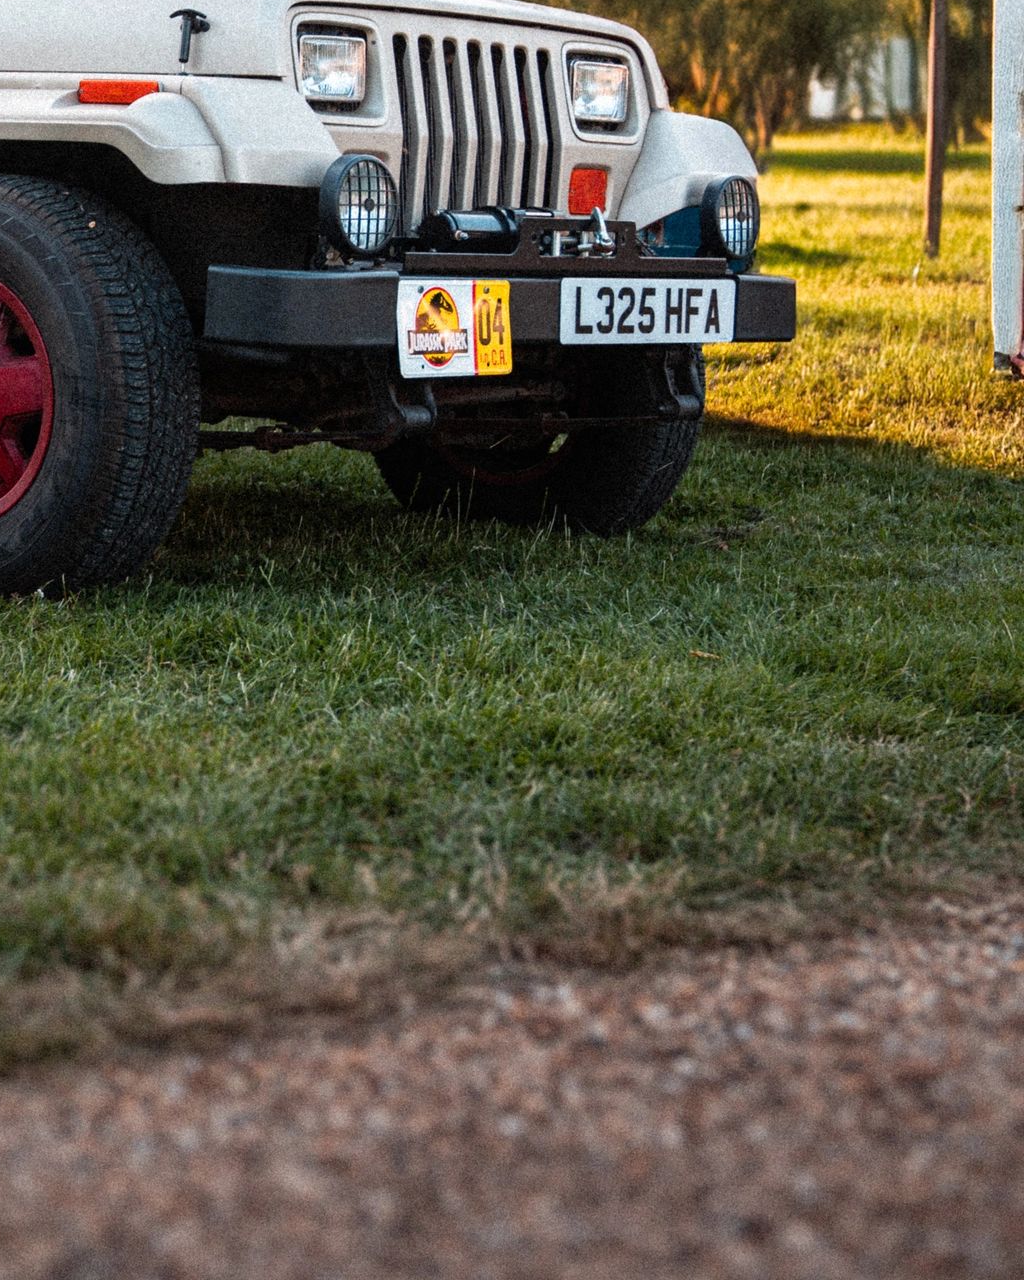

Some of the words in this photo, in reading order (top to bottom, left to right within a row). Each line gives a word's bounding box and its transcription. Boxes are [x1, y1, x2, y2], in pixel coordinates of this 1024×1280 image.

[478, 298, 505, 347] 04
[575, 286, 657, 334] L325
[665, 287, 721, 334] HFA
[409, 331, 443, 354] JURASSIC
